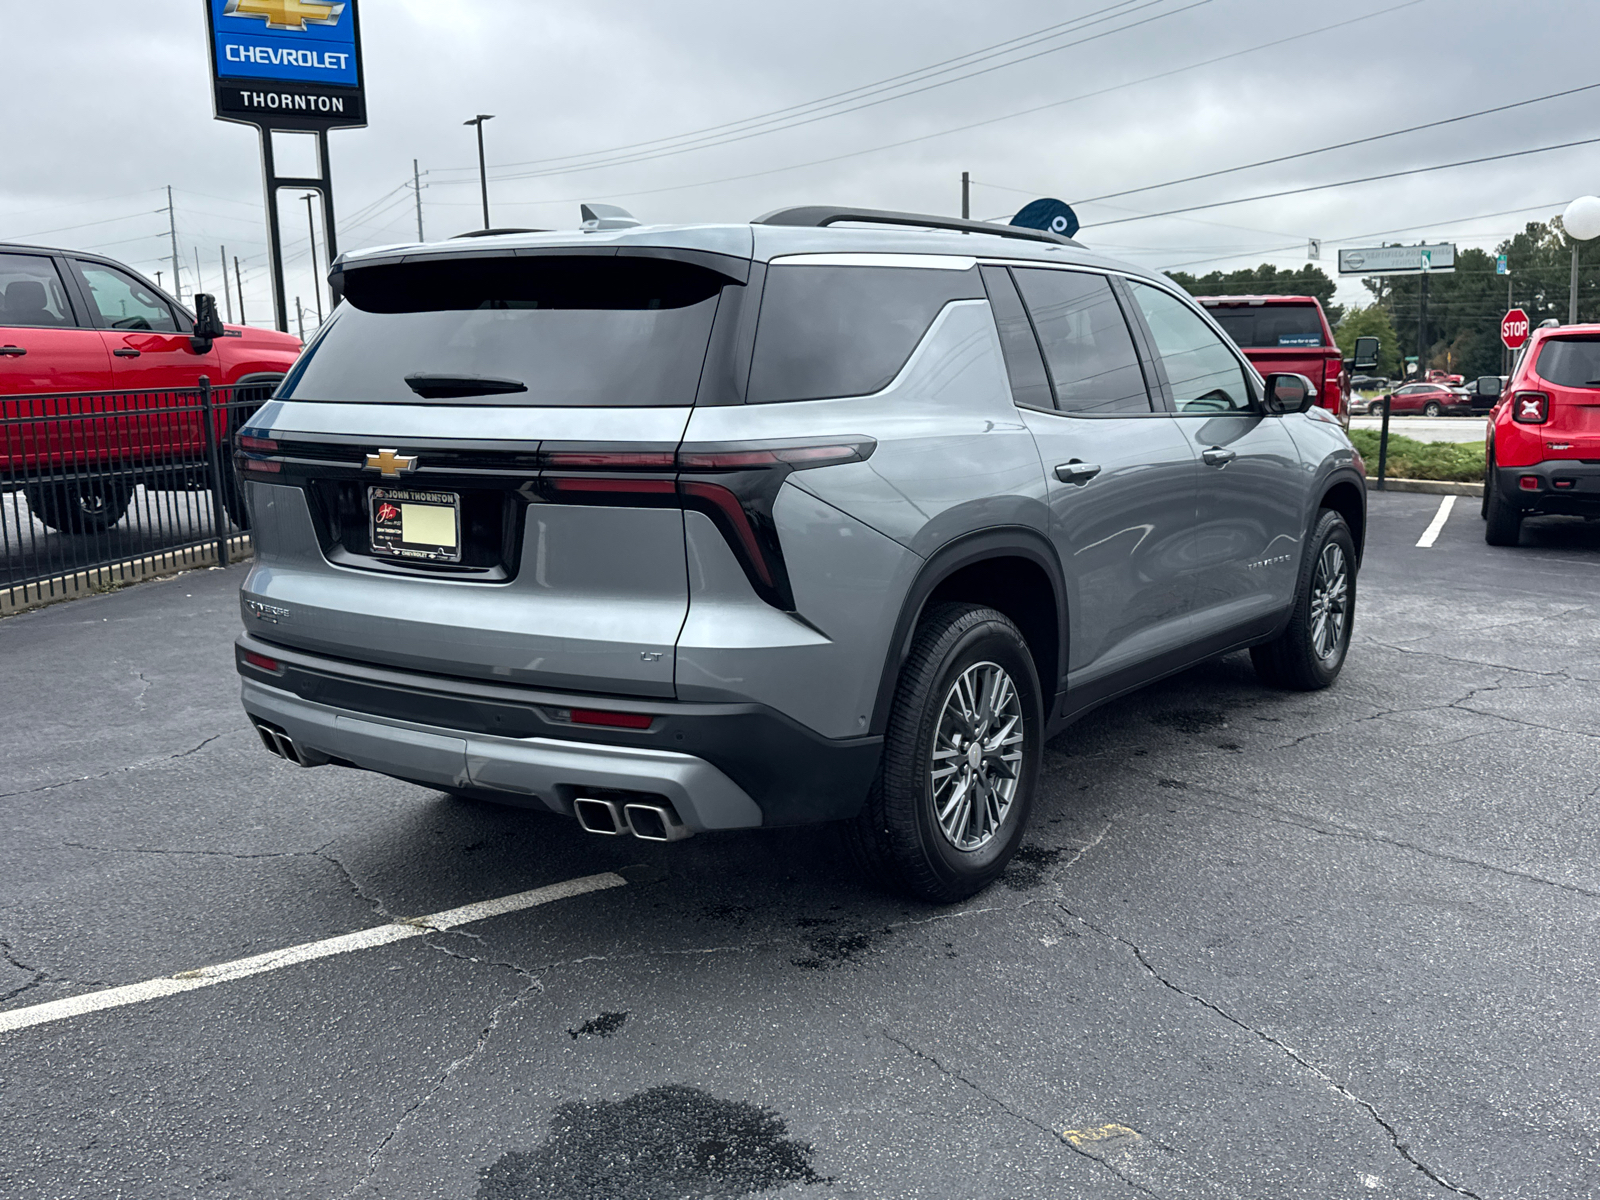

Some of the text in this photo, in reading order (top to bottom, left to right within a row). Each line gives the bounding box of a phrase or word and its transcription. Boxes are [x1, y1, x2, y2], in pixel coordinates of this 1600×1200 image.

[225, 44, 349, 70] CHEVROLET
[240, 91, 344, 113] THORNTON
[1503, 320, 1527, 337] STOP
[389, 490, 454, 503] JOHN THORNTON
[640, 651, 664, 662] LT
